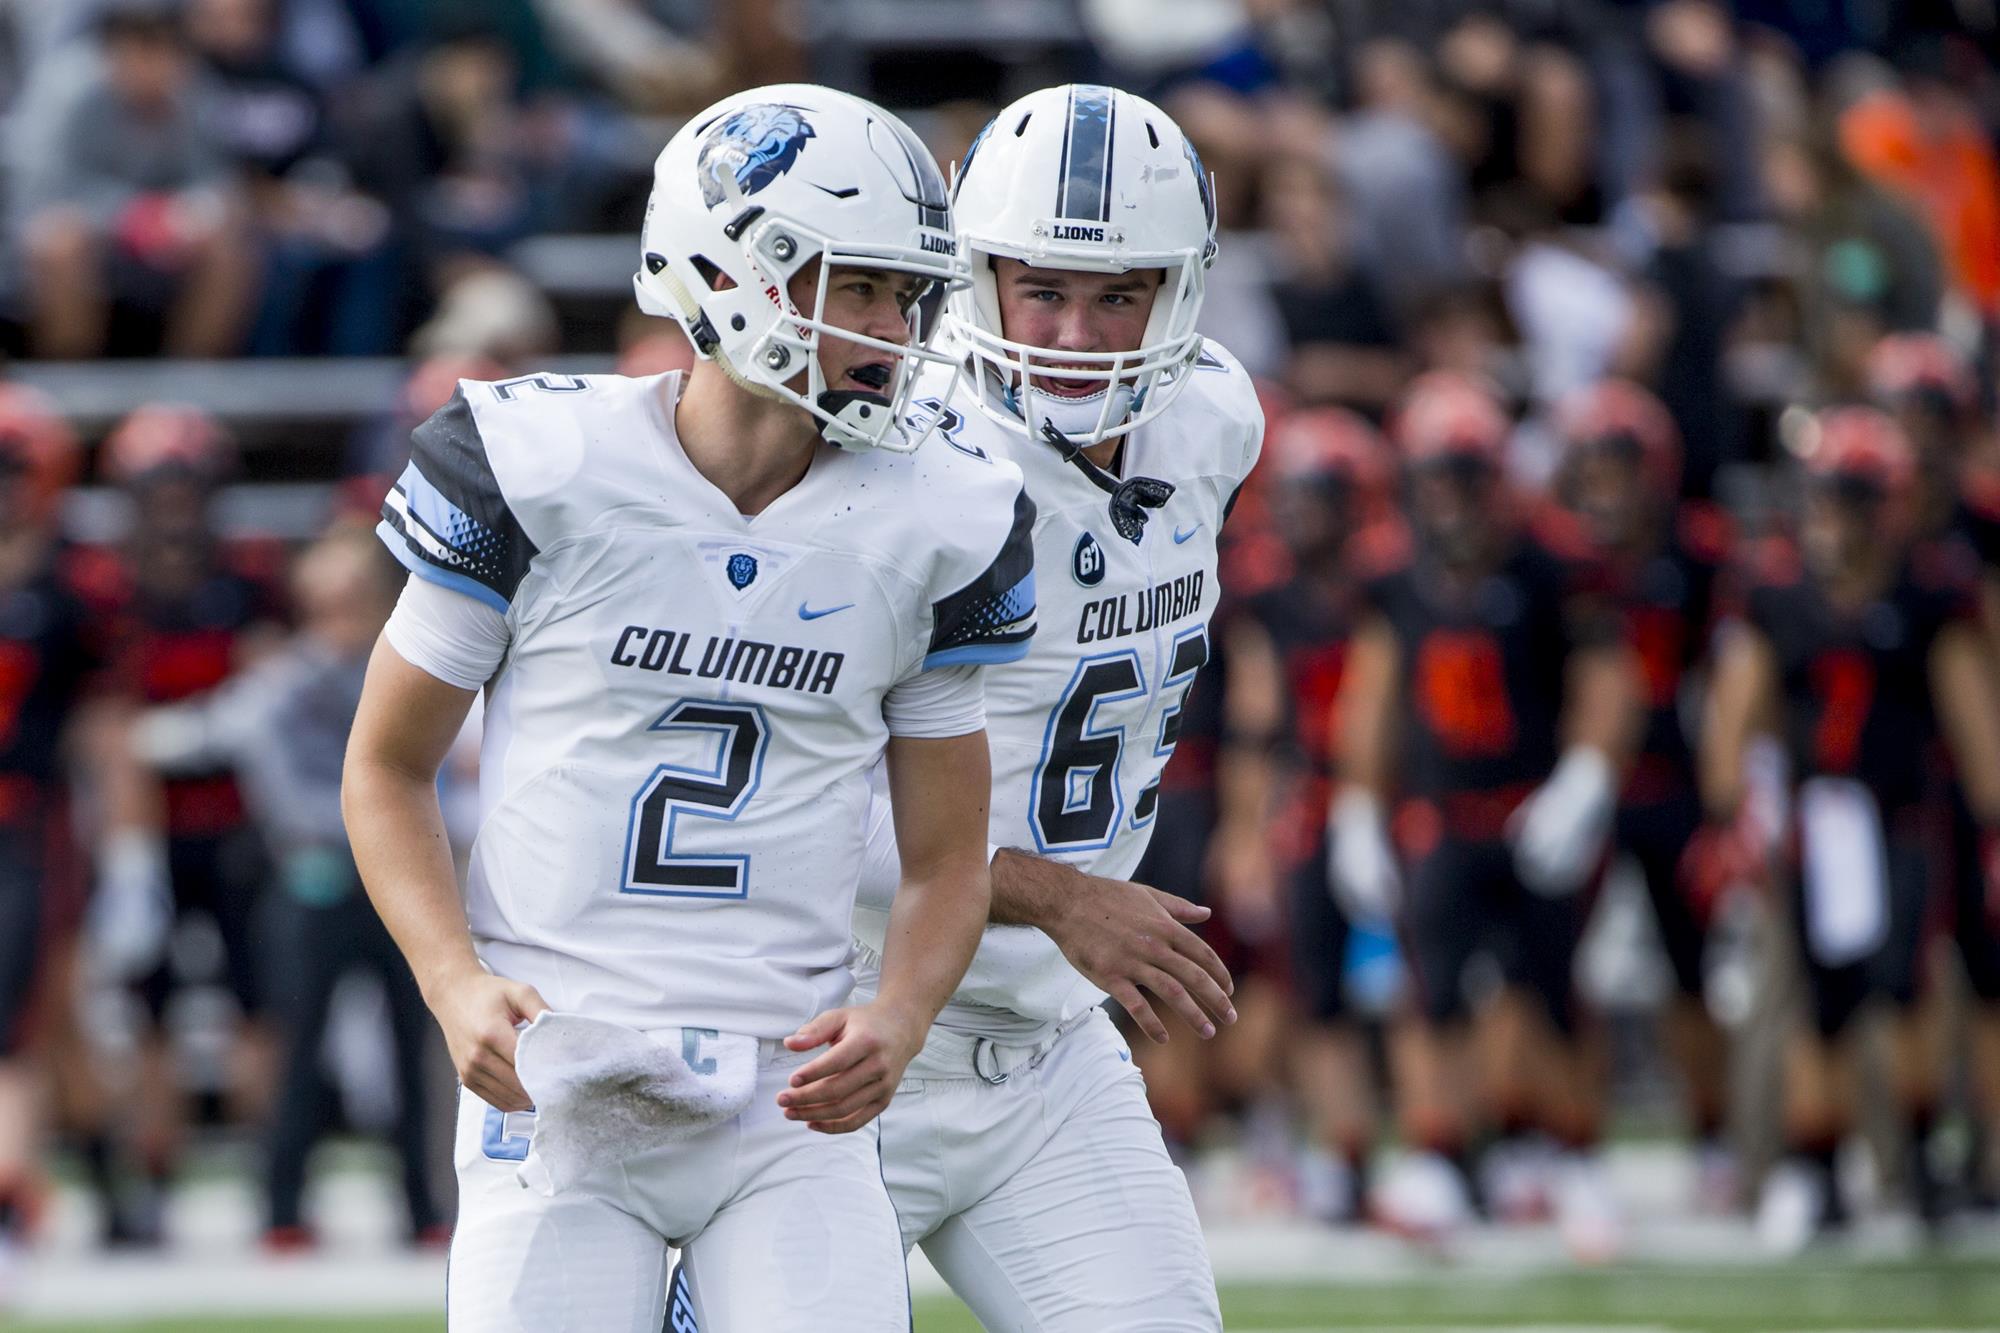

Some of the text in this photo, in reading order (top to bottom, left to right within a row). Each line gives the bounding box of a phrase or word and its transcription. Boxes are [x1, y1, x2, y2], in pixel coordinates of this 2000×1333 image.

[920, 233, 957, 256] LIONS
[1053, 225, 1104, 241] LIONS
[1077, 569, 1204, 644] COLUMBIA
[610, 625, 845, 694] COLUMBIA
[1027, 622, 1209, 854] 63
[619, 696, 772, 900] 2
